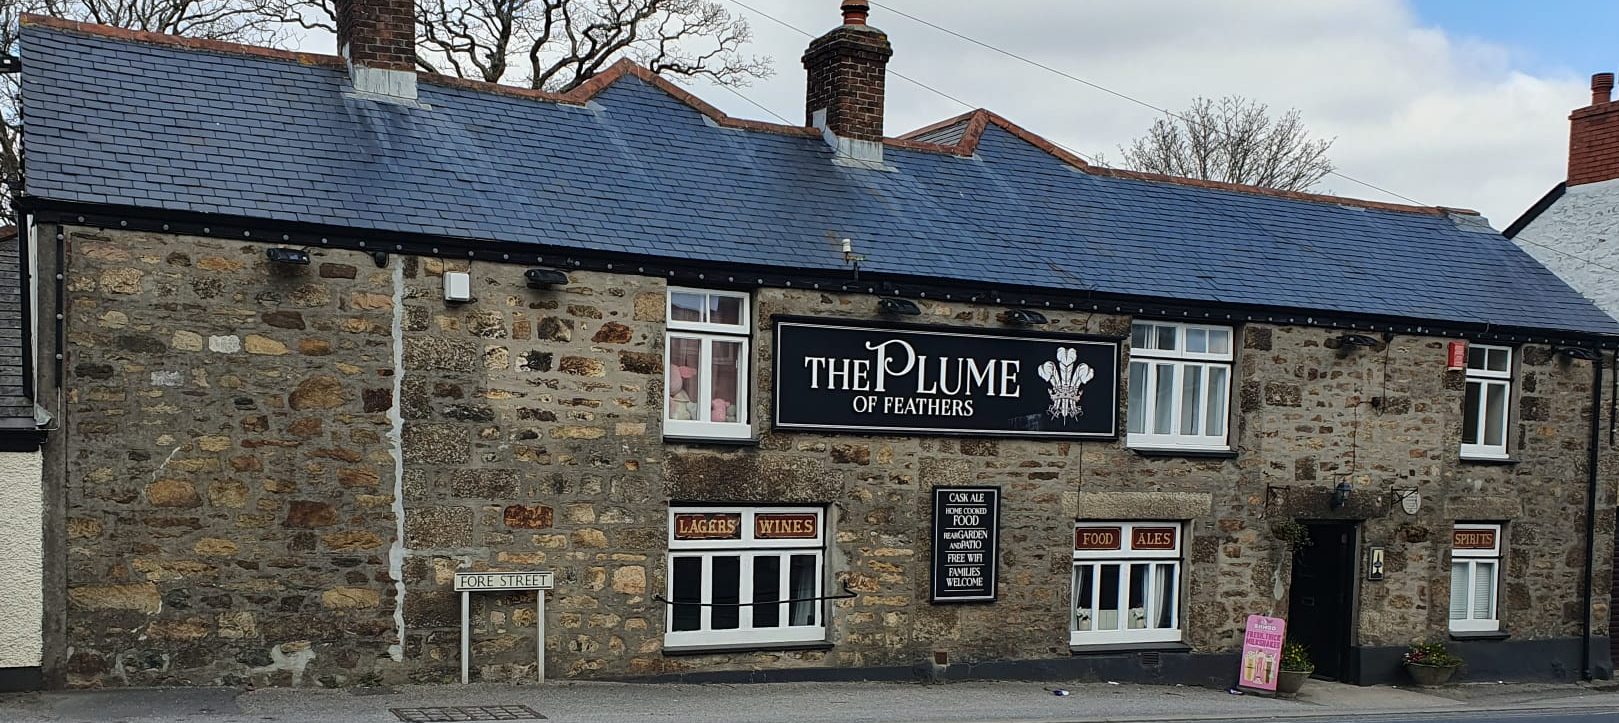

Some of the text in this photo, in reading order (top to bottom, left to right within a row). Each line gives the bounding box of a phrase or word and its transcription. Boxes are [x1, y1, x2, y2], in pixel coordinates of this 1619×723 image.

[804, 339, 1020, 398] THE PLUME
[853, 395, 974, 417] OF FEATHERS
[949, 493, 984, 502] CASK ALE
[679, 519, 814, 534] LAGERS WINES
[953, 515, 979, 526] FOOD
[1082, 532, 1171, 545] FOOD ALES
[1454, 533, 1492, 545] SPIRITS
[947, 553, 982, 562] FREE WIFI
[948, 567, 980, 577] FAMILIES
[460, 574, 547, 587] FORE STREET
[946, 577, 983, 587] WELCOME
